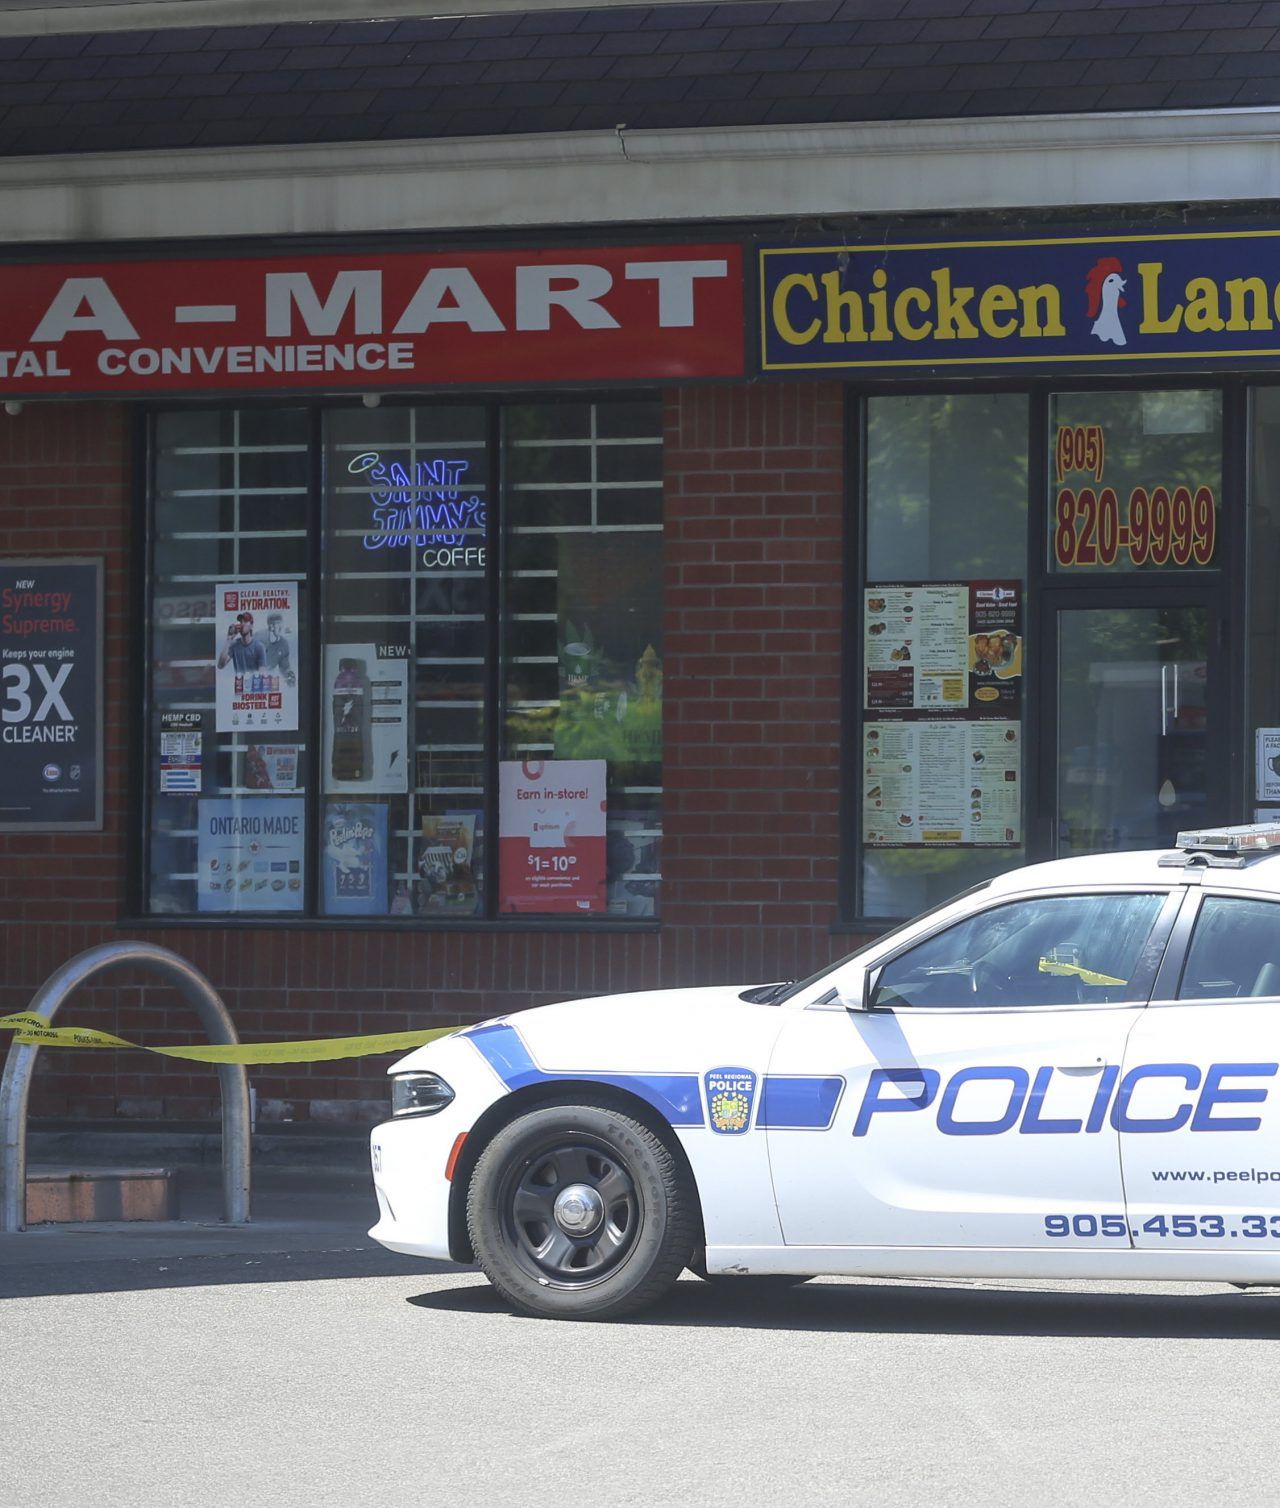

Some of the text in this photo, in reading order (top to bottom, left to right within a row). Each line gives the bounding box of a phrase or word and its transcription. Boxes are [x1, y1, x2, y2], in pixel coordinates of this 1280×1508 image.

[29, 277, 141, 342] A
[265, 259, 728, 337] MART
[772, 267, 1066, 345] Chicken
[97, 342, 415, 375] CONVENIENCE
[1056, 424, 1104, 483] (905)
[362, 457, 469, 507] SAINT
[1055, 485, 1216, 566] 820-9999
[16, 580, 35, 590] NEW
[2, 588, 72, 613] Synergy
[240, 597, 291, 611] HYDRATION.
[2, 648, 74, 660] Keeps your engine
[379, 646, 407, 657] NEW
[2, 663, 75, 723] 3X
[233, 701, 267, 710] BIOSTEEL
[162, 714, 184, 722] HEMP
[517, 788, 589, 800] Earn in-store!
[210, 816, 299, 836] ONTARIO MADE
[709, 1080, 752, 1091] POLICE
[852, 1062, 1279, 1137] POLICE
